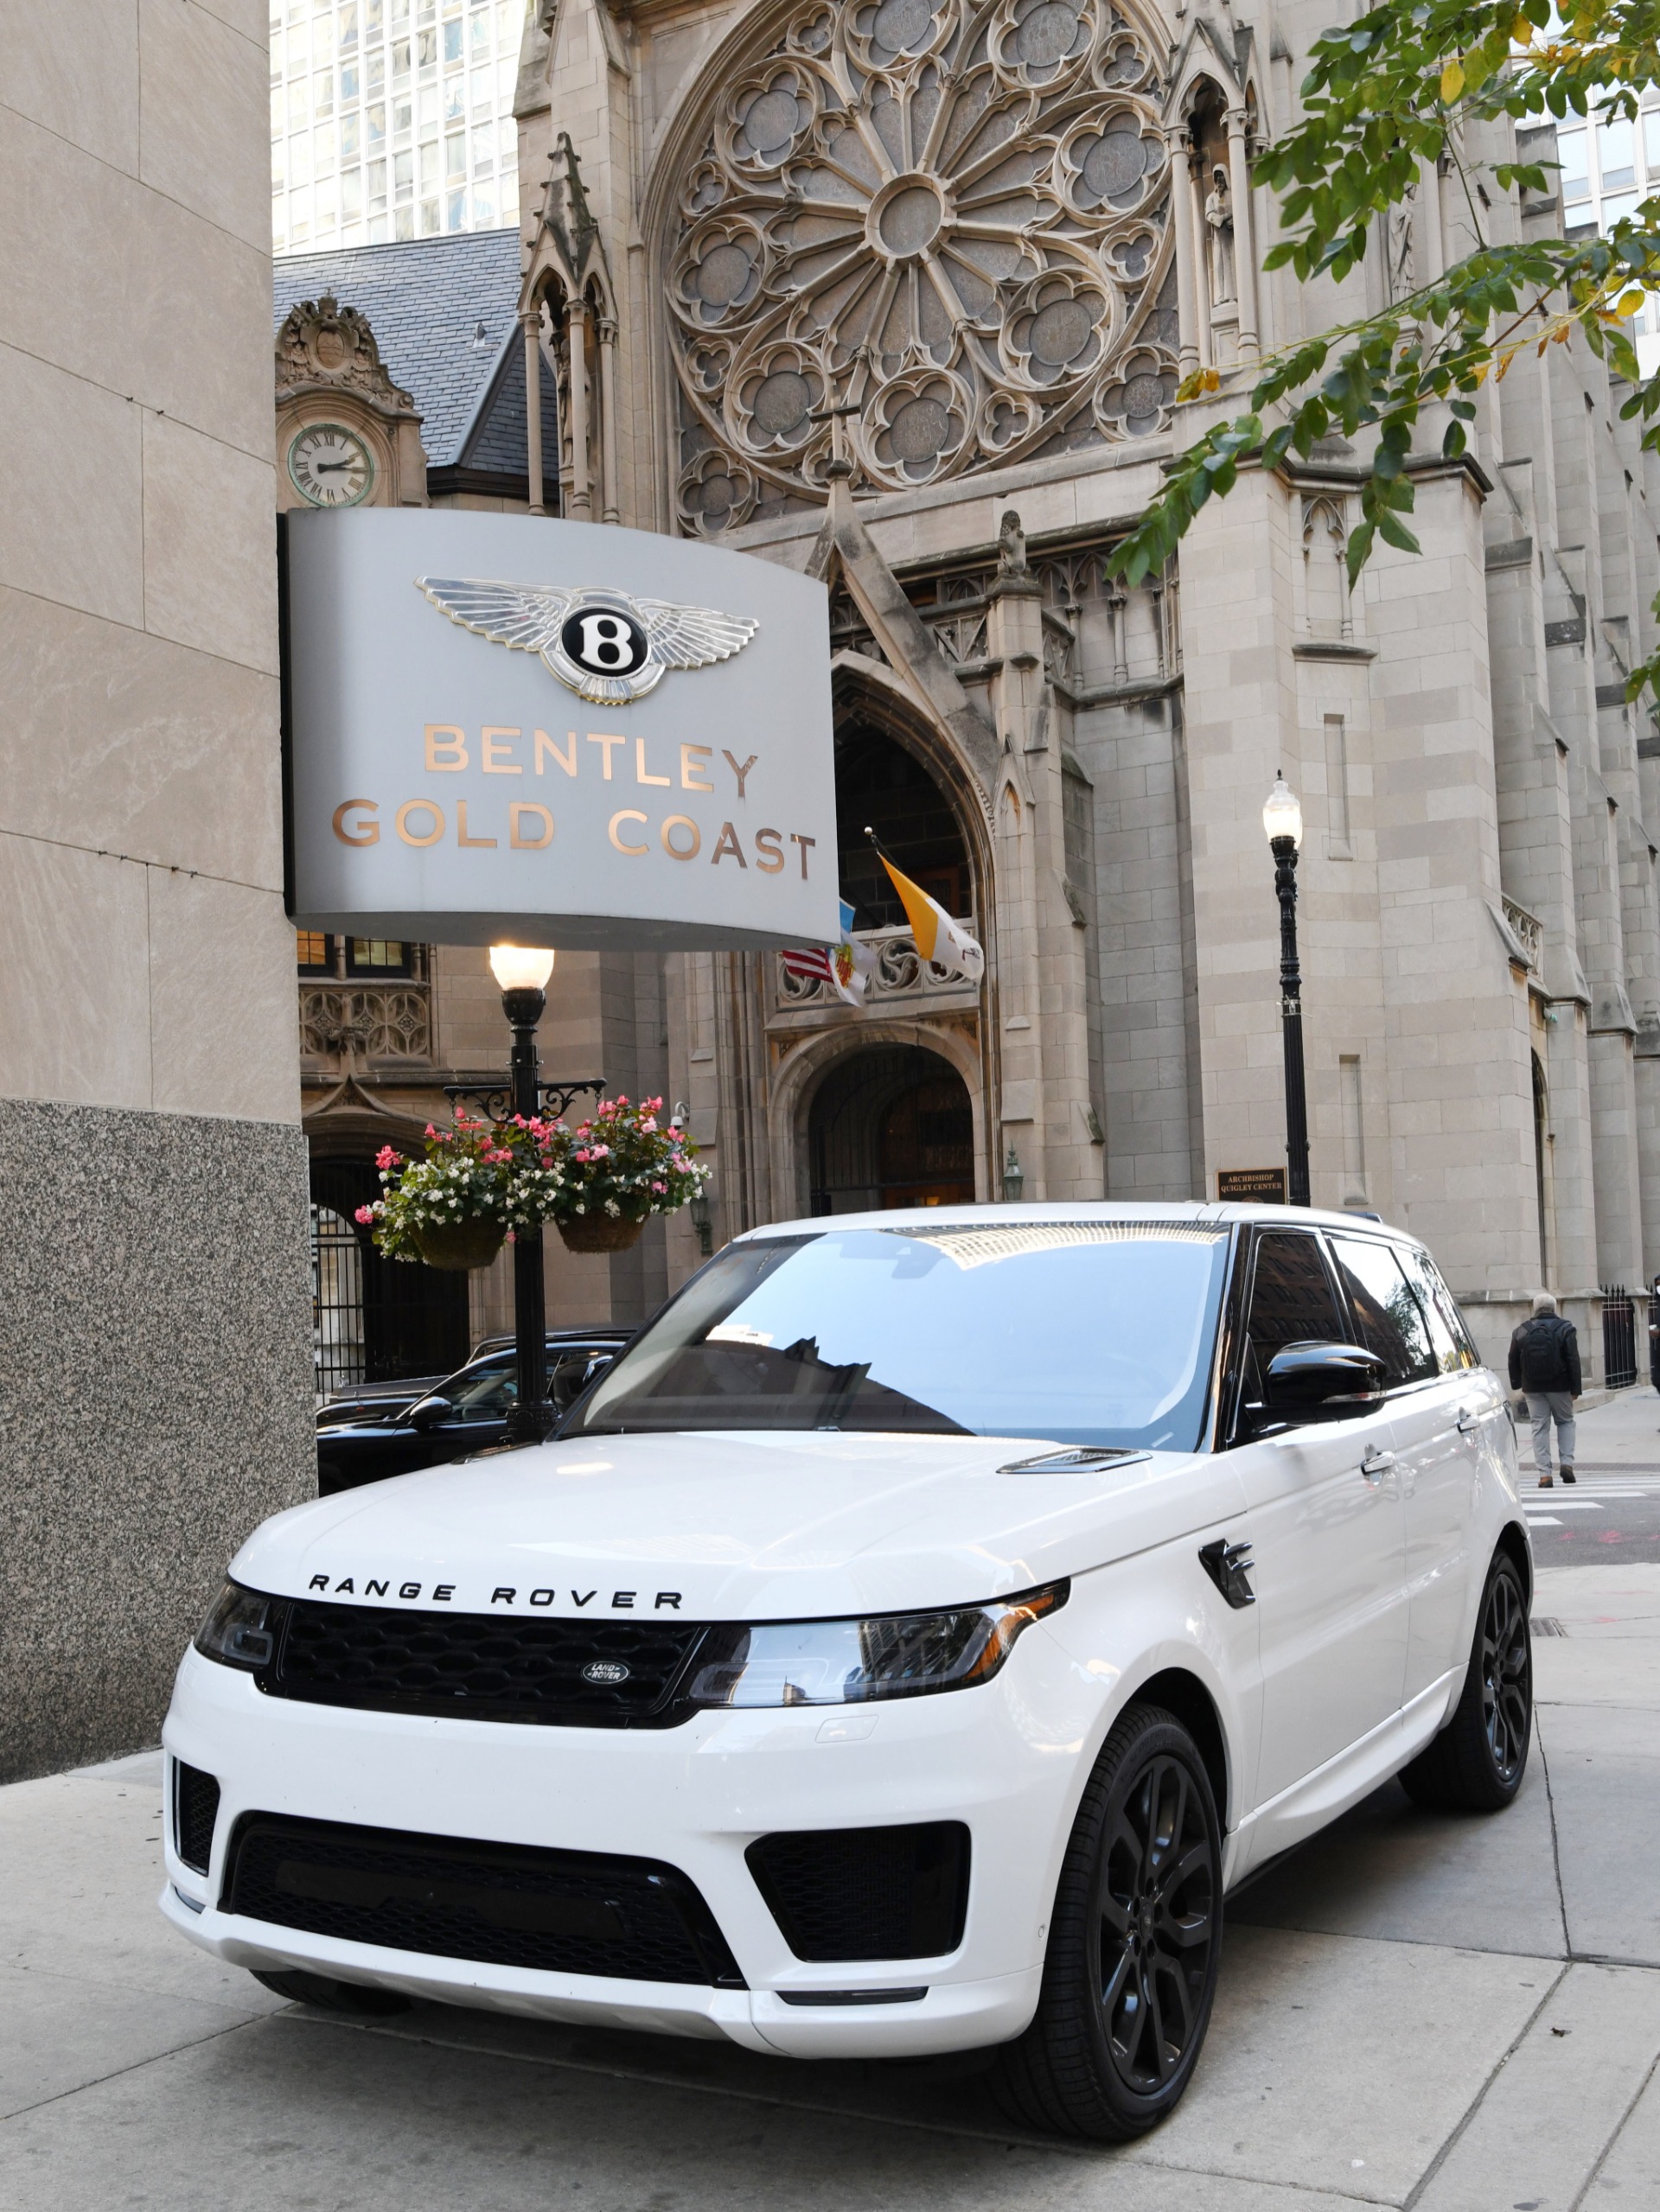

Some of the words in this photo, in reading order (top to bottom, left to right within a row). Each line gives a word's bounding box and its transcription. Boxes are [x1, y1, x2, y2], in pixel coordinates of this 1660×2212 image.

[324, 434, 335, 447] XII
[580, 614, 634, 670] B
[424, 724, 758, 798] BENTLEY
[331, 799, 555, 850] GOLD
[608, 809, 816, 880] COAST
[1221, 1183, 1252, 1193] QUIGLEY
[1228, 1174, 1274, 1182] ARCHBISHOP
[309, 1574, 456, 1601] RANGE
[490, 1587, 683, 1610] ROVER
[591, 1671, 621, 1680] ROVER
